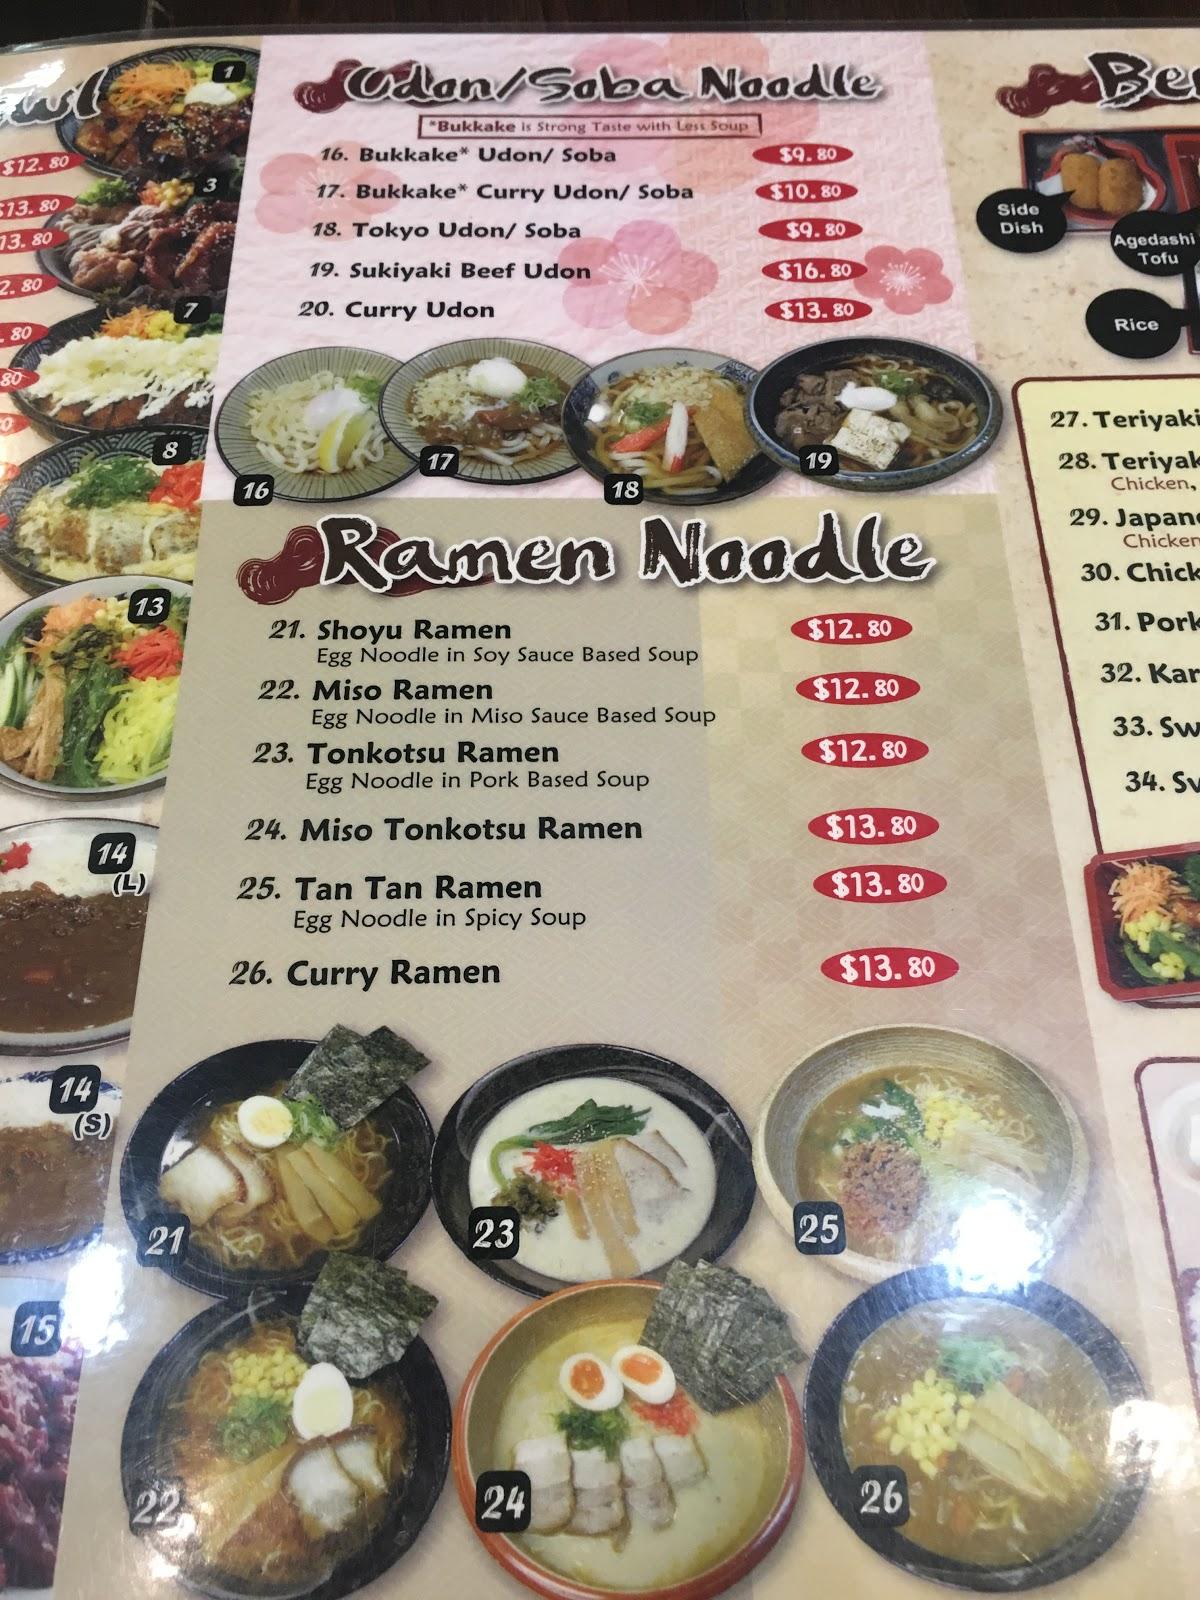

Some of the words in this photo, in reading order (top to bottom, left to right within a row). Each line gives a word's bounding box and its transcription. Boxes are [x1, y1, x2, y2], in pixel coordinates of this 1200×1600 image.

[223, 65, 235, 79] 1
[1085, 49, 1200, 108] Be
[345, 62, 690, 104] Udon/Soba
[698, 62, 884, 102] Noodle
[522, 122, 532, 133] is
[537, 121, 586, 136] Strong
[593, 120, 632, 134] Taste
[636, 120, 672, 133] with
[676, 120, 706, 133] Less
[711, 120, 749, 136] Soup
[321, 148, 349, 162] 16.
[478, 147, 554, 163] Udon/
[562, 147, 616, 162] Soba
[203, 178, 217, 192] 3
[316, 184, 346, 198] 17.
[476, 184, 545, 203] Curry
[554, 184, 630, 201] Udon/
[638, 184, 694, 200] Soba
[997, 204, 1040, 218] Side
[312, 222, 342, 237] 18.
[352, 222, 430, 241] Tokyo
[439, 222, 518, 239] Udon/
[525, 222, 582, 239] Soba
[1000, 221, 1044, 236] Dish
[1113, 232, 1196, 250] Agedashi
[1137, 252, 1180, 266] Tofu
[309, 262, 340, 278] 19.
[350, 262, 452, 282] Sukiyaki
[460, 262, 516, 279] Beef
[524, 263, 592, 280] Udon
[183, 302, 199, 319] 7
[298, 301, 335, 318] 20.
[345, 301, 418, 322] Curry
[426, 301, 495, 318] Udon
[1114, 318, 1160, 333] Rice
[1050, 410, 1088, 428] 27.
[1092, 408, 1200, 432] Teriyaki
[162, 441, 179, 460] 8
[804, 452, 832, 469] 19
[1058, 452, 1097, 470] 28.
[427, 452, 454, 471] 17
[242, 482, 270, 500] 16
[611, 480, 640, 499] 18
[1110, 476, 1197, 492] Chicken,
[1070, 508, 1109, 526] 29.
[316, 513, 615, 593] Ramen
[638, 508, 937, 588] Noodle
[1123, 533, 1200, 549] Chicken
[1080, 562, 1120, 583] 30.
[135, 596, 165, 617] 13
[1094, 611, 1130, 632] 31.
[268, 619, 306, 640] 21.
[317, 619, 402, 646] Shoyu
[414, 619, 512, 640] Ramen
[317, 648, 352, 668] Egg
[360, 646, 440, 663] Noodle
[447, 646, 465, 662] in
[474, 646, 510, 666] Soy
[518, 646, 574, 663] Sauce
[582, 646, 640, 662] Based
[648, 646, 699, 666] Soup
[1100, 662, 1142, 684] 32.
[258, 680, 300, 700] 22.
[312, 680, 382, 701] Miso
[393, 679, 494, 701] Ramen
[311, 708, 348, 730] Egg
[356, 708, 436, 725] Noodle
[444, 708, 464, 724] in
[471, 707, 524, 724] Miso
[530, 706, 589, 724] Sauce
[597, 706, 657, 724] Based
[664, 706, 717, 728] Soup
[1113, 716, 1154, 737] 33.
[252, 742, 294, 764] 23.
[307, 742, 446, 765] Tonkotsu
[457, 741, 560, 764] Ramen
[306, 772, 342, 795] Egg
[351, 772, 434, 790] Noodle
[442, 772, 461, 788] in
[470, 771, 520, 788] Pork
[528, 771, 588, 788] Based
[596, 770, 650, 793] Soup
[1125, 770, 1166, 792] 34.
[244, 818, 287, 842] 24.
[300, 818, 373, 842] Miso
[384, 817, 526, 841] Tonkotsu
[538, 816, 643, 840] Ramen
[96, 842, 128, 866] 14
[112, 873, 147, 896] (L)
[236, 876, 281, 901] 25.
[295, 876, 352, 902] Tan
[364, 876, 423, 900] Tan
[436, 875, 542, 900] Ramen
[294, 910, 332, 934] Egg
[341, 909, 427, 928] Noodle
[436, 908, 456, 927] in
[465, 908, 523, 932] Spicy
[530, 907, 587, 931] Soup
[228, 960, 273, 986] 26.
[287, 960, 379, 993] Curry
[390, 959, 501, 984] Ramen
[59, 1076, 92, 1104] 14
[74, 1113, 112, 1140] (S)
[472, 1218, 515, 1250] 23
[798, 1213, 840, 1245] 25
[145, 1225, 185, 1256] 21
[20, 1314, 57, 1346] 15
[481, 1484, 526, 1520] 24
[860, 1480, 904, 1514] 26
[132, 1490, 182, 1526] 22
